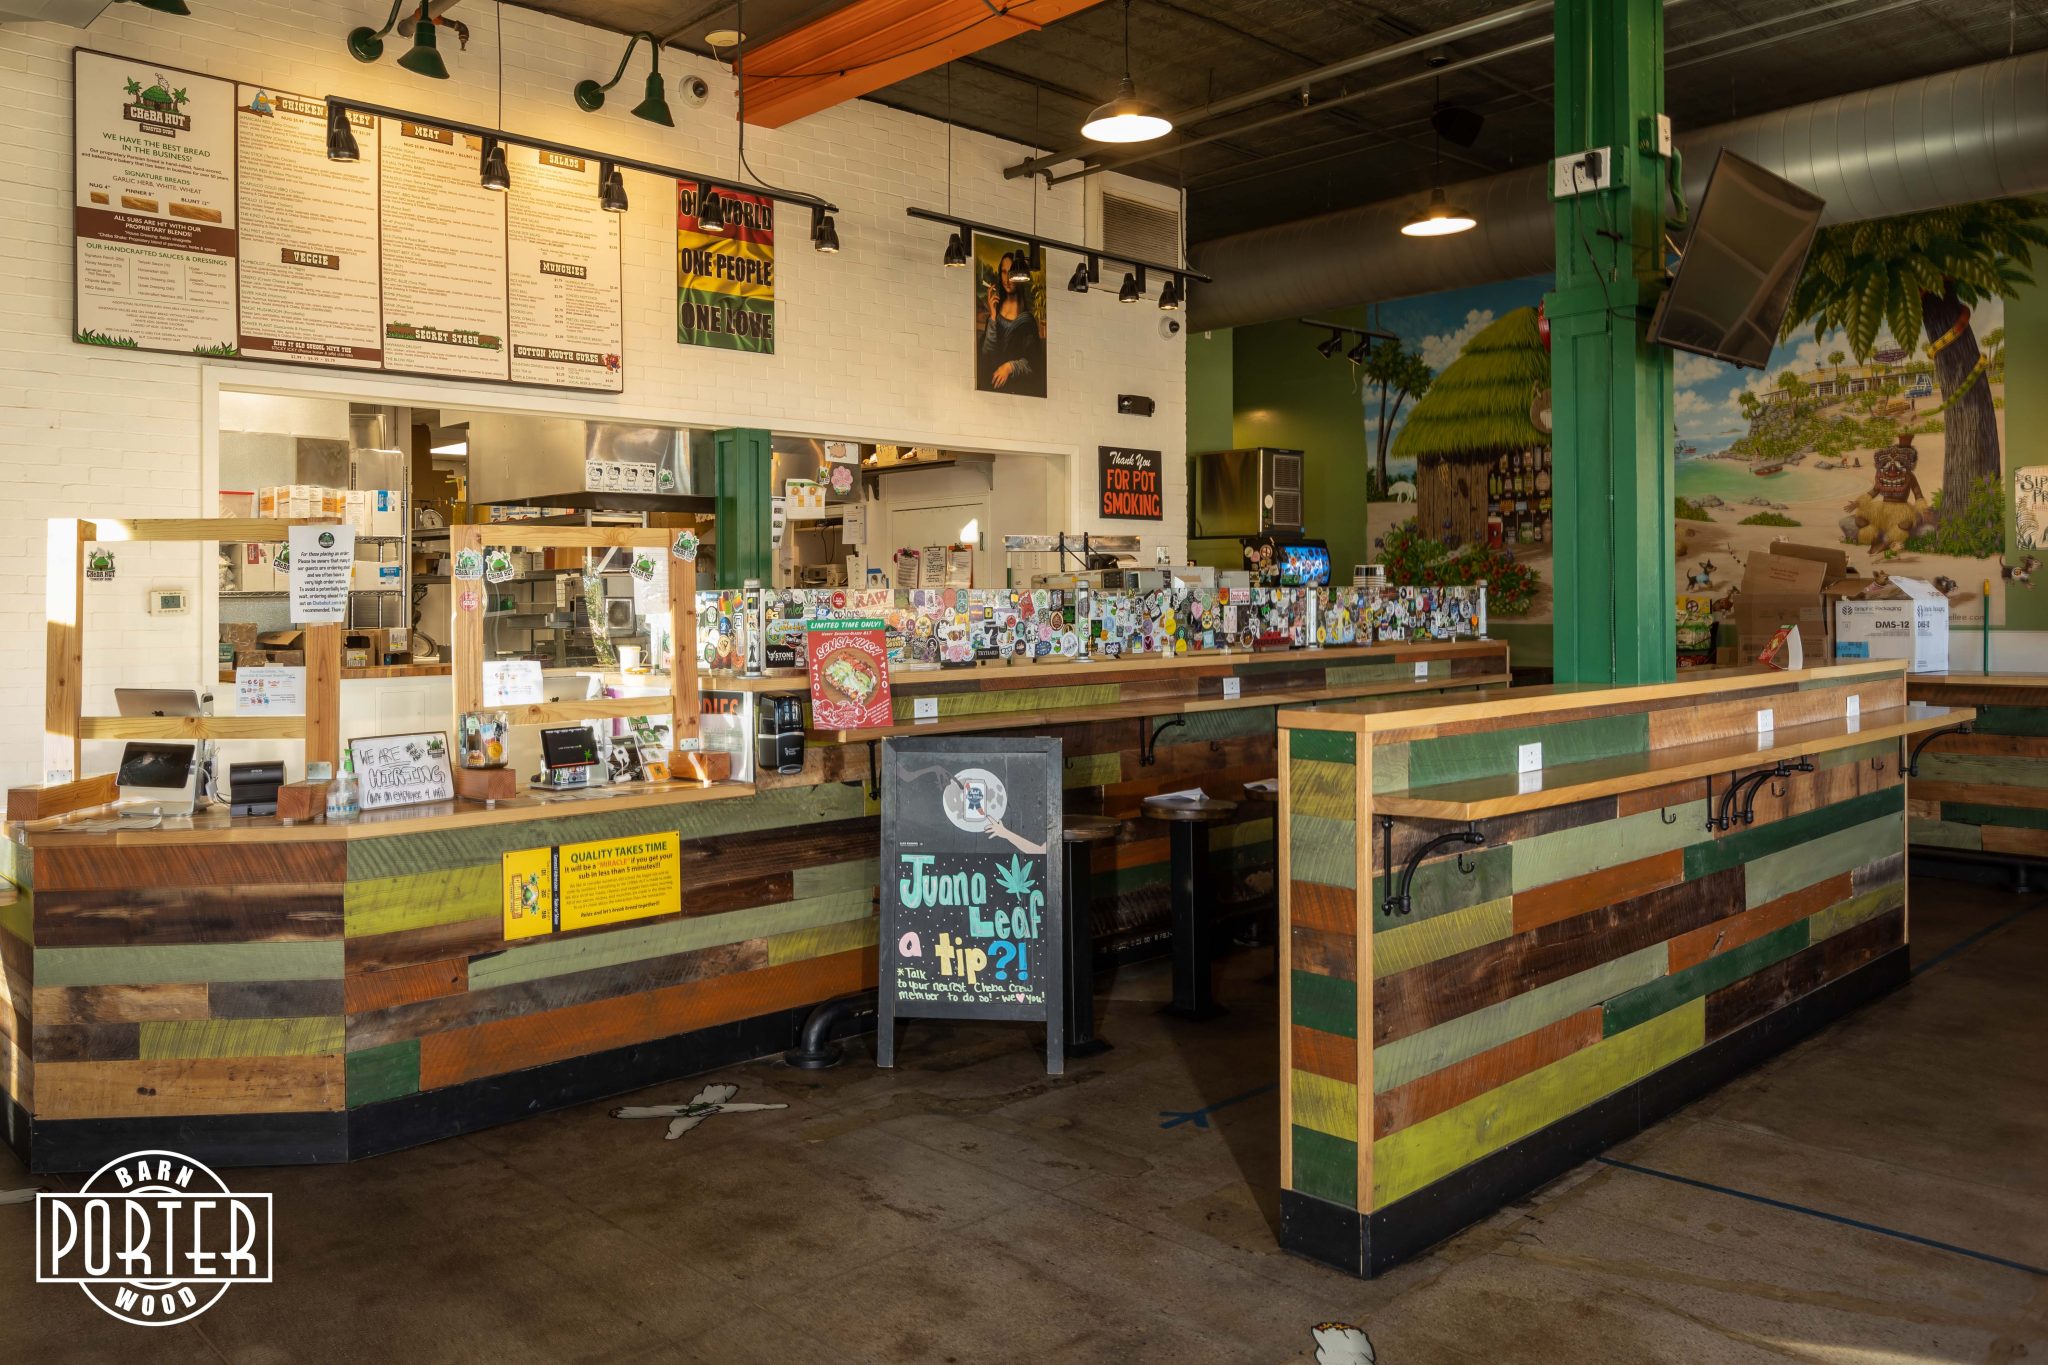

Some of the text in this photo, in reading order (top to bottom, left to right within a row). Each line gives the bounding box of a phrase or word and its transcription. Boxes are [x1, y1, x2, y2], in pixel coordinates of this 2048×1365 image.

[165, 111, 185, 126] HUT
[282, 100, 371, 125] CHICKEN RKEY
[415, 126, 439, 139] MEAT
[103, 132, 116, 140] WE
[119, 135, 141, 145] HAVE
[163, 143, 180, 152] BEST
[184, 147, 210, 158] BREAD
[134, 146, 150, 155] THE
[153, 150, 192, 162] BUSINESS!
[550, 155, 579, 168] SALADS
[113, 175, 135, 184] GARLIC
[180, 185, 202, 194] WHEAT
[125, 169, 190, 185] SIGNATURE BREADS
[720, 196, 772, 231] WORLD
[126, 223, 192, 237] PROPRIETARY BLENDS!
[104, 244, 157, 257] HANDCRAFTED
[159, 252, 184, 260] SAUCES
[192, 256, 228, 266] DRESSINGS
[294, 251, 329, 266] VEGGIE
[543, 262, 585, 276] MUNCHIES
[681, 248, 772, 286] ONE PEOPLE
[681, 302, 772, 339] ONE LOVE
[415, 329, 479, 345] SECRET STASH
[518, 347, 598, 363] COTTON MOUTH CURES
[1110, 451, 1151, 470] Thank You
[1107, 468, 1156, 492] FOR POT
[855, 590, 889, 609] RAW
[1875, 621, 1910, 629] DMS-12
[816, 637, 884, 660] SENSI-KUSH
[360, 748, 374, 765] WE
[379, 746, 400, 763] ARE
[368, 765, 445, 788] HIRING
[570, 841, 667, 863] QUALITY TAKES TIME
[597, 858, 629, 868] "MIRACLE"
[636, 858, 646, 866] you
[648, 856, 658, 864] get
[659, 853, 673, 862] your
[599, 869, 610, 877] less
[632, 863, 661, 872] minutes!!!
[900, 854, 987, 909] Juana
[968, 889, 1045, 939] Leaf
[898, 931, 1029, 985] a tip?!
[897, 979, 1033, 995] to your nearest Cheba Crew
[898, 990, 939, 1000] member
[948, 992, 958, 1001] to
[963, 993, 975, 1001] do
[979, 992, 993, 1002] so!
[1026, 992, 1045, 1004] you!
